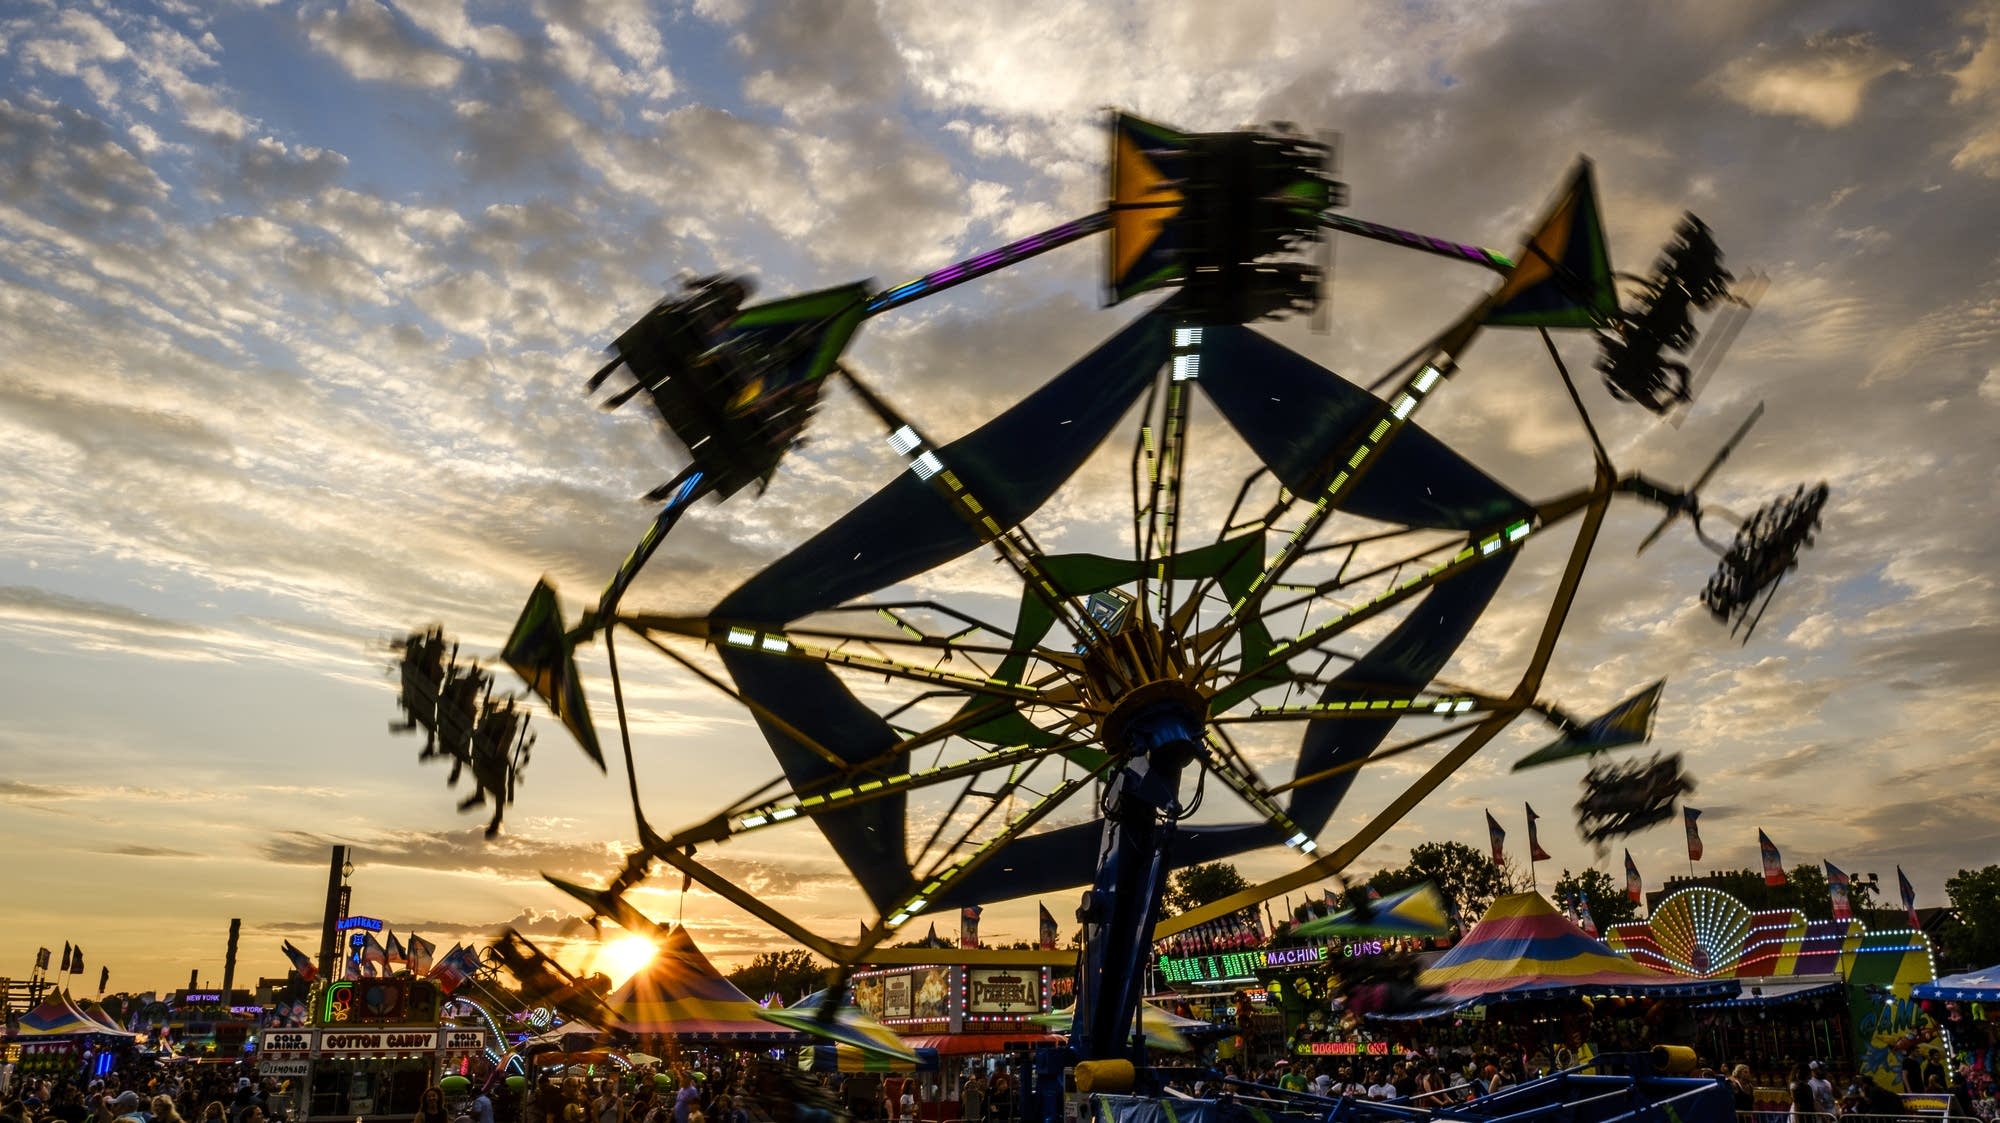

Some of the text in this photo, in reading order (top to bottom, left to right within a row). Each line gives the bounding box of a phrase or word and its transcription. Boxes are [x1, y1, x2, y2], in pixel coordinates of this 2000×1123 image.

[337, 917, 382, 931] KAMIKAZE
[1268, 940, 1383, 966] MACHINE GUNS
[186, 994, 220, 1002] NEW YORK
[973, 981, 1037, 1006] PIZZERIA
[274, 1034, 303, 1042] COLD
[454, 1033, 477, 1041] COLD
[267, 1041, 308, 1050] DRINKS
[327, 1034, 432, 1050] COTTON CANDY
[448, 1040, 481, 1048] DRINKS
[269, 1065, 308, 1074] LEMONADE
